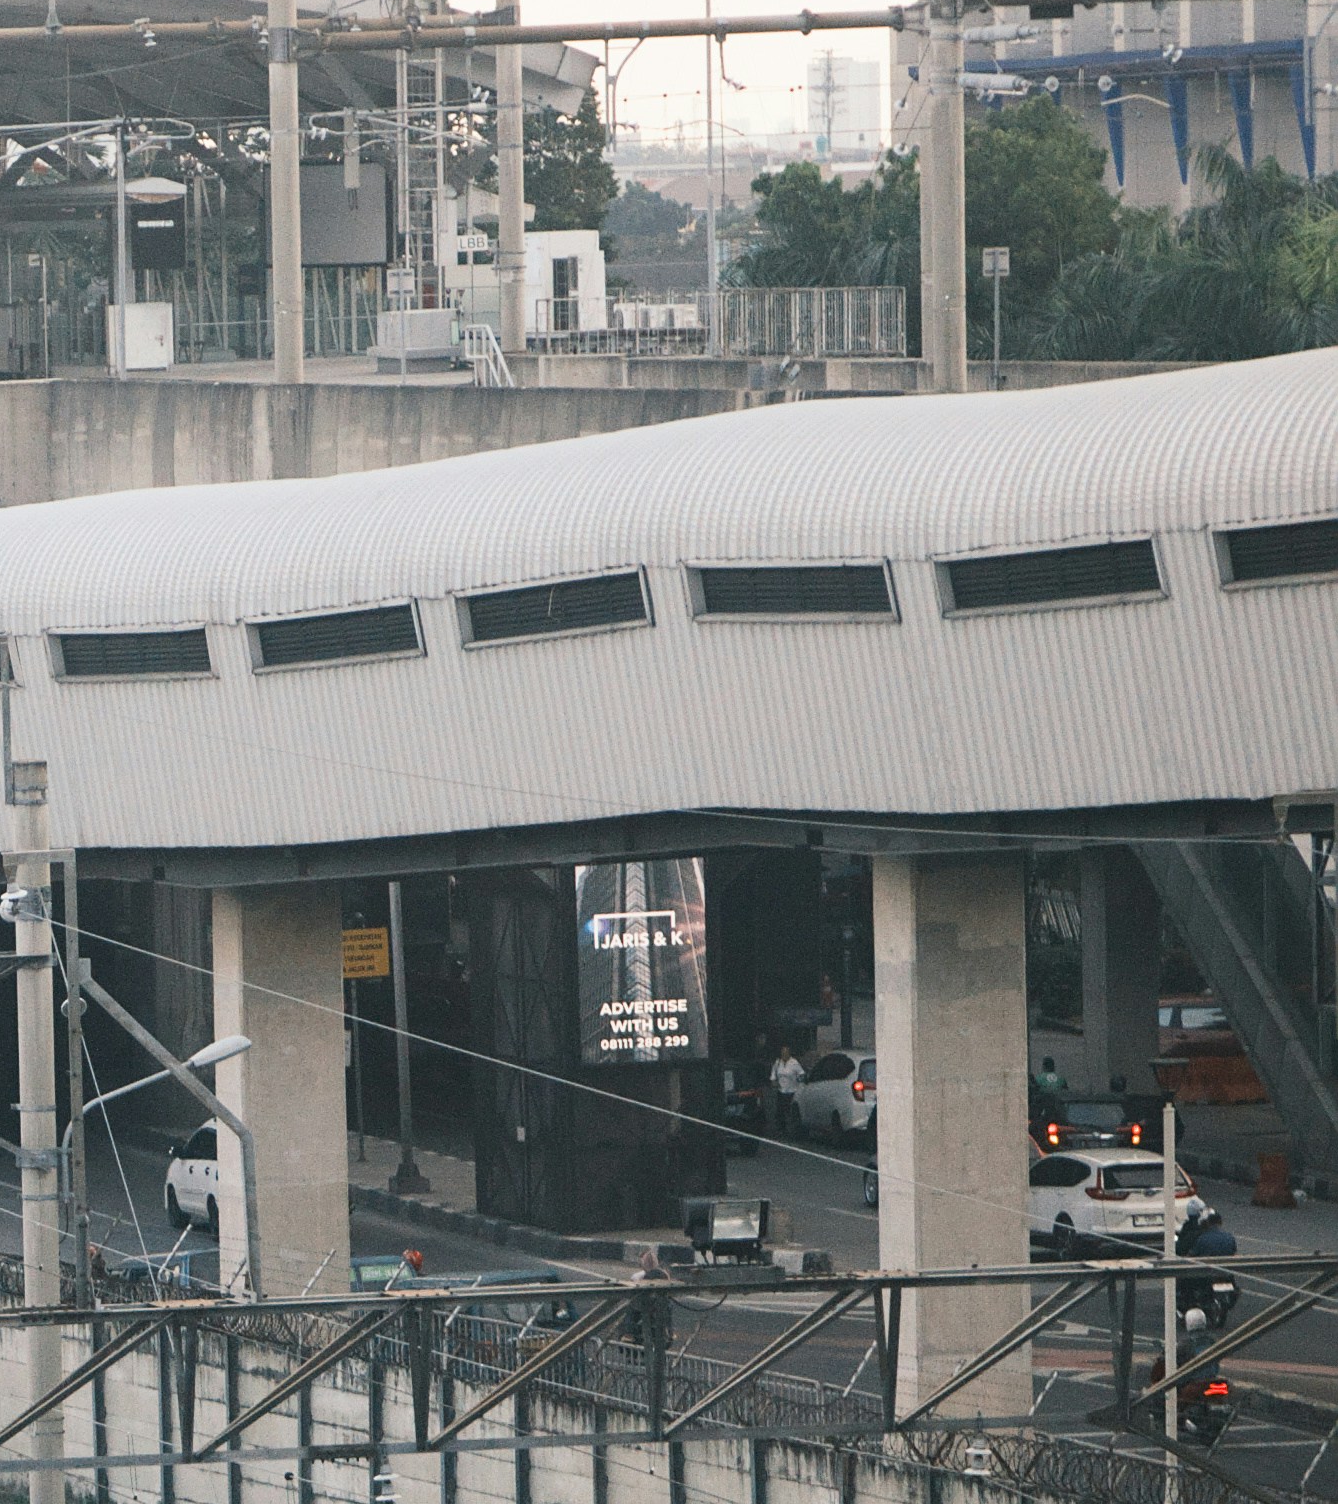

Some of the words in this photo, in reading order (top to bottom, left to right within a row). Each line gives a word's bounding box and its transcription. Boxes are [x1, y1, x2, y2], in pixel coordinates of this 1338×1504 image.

[459, 237, 485, 249] LBB
[601, 932, 650, 949] JARIS
[653, 931, 667, 947] &
[671, 930, 684, 946] K
[599, 999, 688, 1016] ADVERTISE
[610, 1018, 654, 1034] WITH
[657, 1017, 679, 1031] US
[600, 1037, 634, 1051] 08111
[636, 1036, 662, 1049] 288
[664, 1035, 689, 1047] 299
